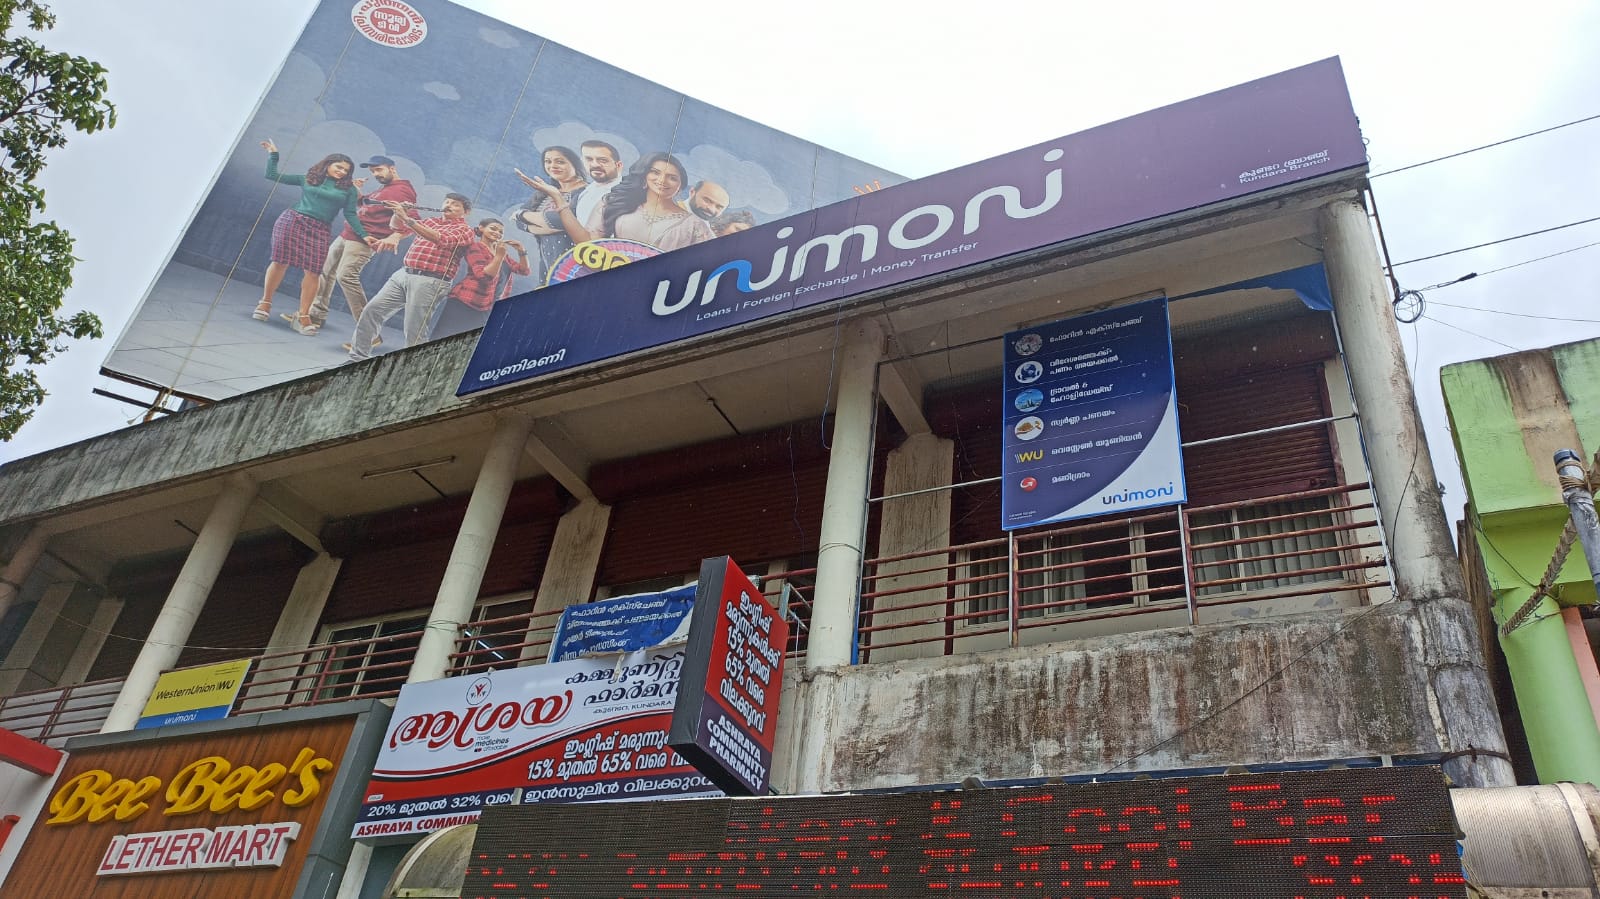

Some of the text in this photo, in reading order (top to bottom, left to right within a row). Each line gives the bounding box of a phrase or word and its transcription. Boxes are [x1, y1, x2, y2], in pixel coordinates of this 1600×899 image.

[1240, 156, 1331, 184] Kundara Branch
[652, 149, 1064, 317] unimoni
[695, 307, 732, 321] Loans
[743, 290, 791, 309] Foreign
[795, 272, 858, 296] Exchange
[871, 258, 917, 276] Money
[921, 241, 979, 262] Transfer
[1015, 449, 1044, 463] WU
[1102, 481, 1174, 505] unimoni
[727, 625, 771, 685] 15% മുതൽ
[725, 651, 765, 706] 65% വരെ
[164, 710, 199, 725] unimoni
[389, 689, 574, 750] ആശ്രയ
[631, 700, 672, 711] KUNDARA
[475, 737, 510, 747] medicines
[564, 730, 619, 758] ഇംഗ്ലീഷ്
[707, 719, 766, 778] COMMUNITY
[718, 715, 761, 762] ASHRAYA
[527, 758, 555, 780] 15%
[557, 755, 598, 780] മുതൽ
[601, 751, 632, 773] 65%
[635, 752, 667, 770] വരെ
[709, 735, 763, 791] PHARMACY
[46, 769, 161, 826] Bee
[367, 803, 396, 817] 20%
[400, 798, 447, 815] മുതൽ
[451, 795, 481, 809] 32%
[525, 781, 619, 801] ഇൻസുലിൻ
[356, 814, 480, 836] ASHRAYA COMMUN
[100, 826, 291, 872] LETHER MART
